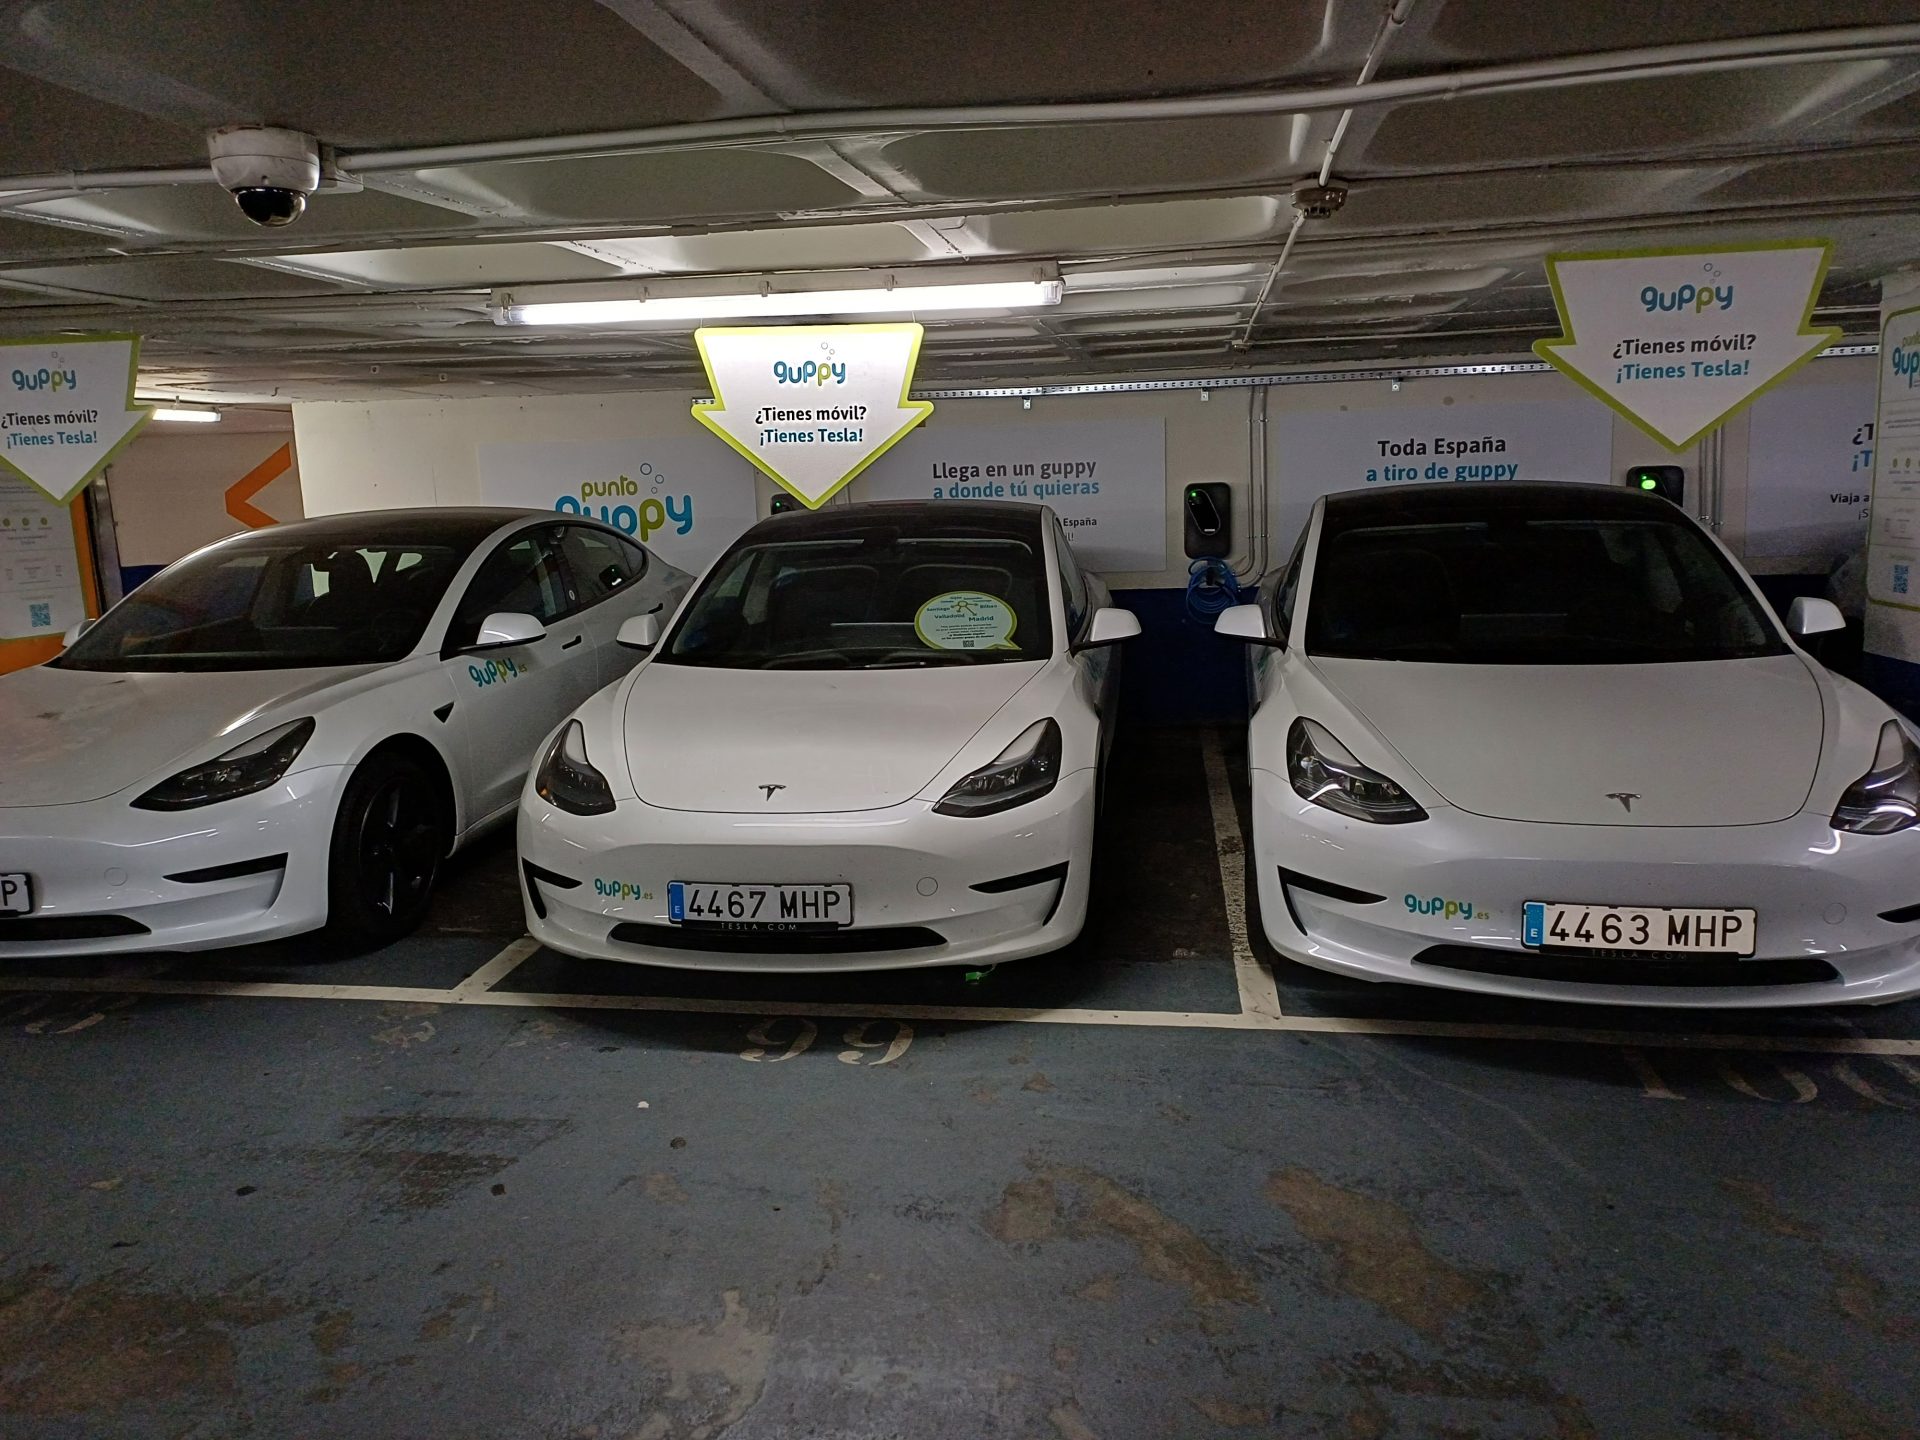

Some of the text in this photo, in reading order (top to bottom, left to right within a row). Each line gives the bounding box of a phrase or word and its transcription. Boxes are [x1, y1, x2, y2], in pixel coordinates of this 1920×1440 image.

[1640, 284, 1734, 313] guppy
[1612, 334, 1757, 359] ¿Tienes móvil?
[12, 368, 77, 392] guppy
[773, 360, 846, 386] guppy
[1616, 359, 1750, 384] ¡Tienes Tesla!
[1, 409, 98, 429] ¿Tienes móvil?
[755, 405, 867, 425] ¿Tienes móvil?
[7, 430, 97, 449] ¡Tienes Tesla!
[760, 428, 863, 446] ¡Tienes Tesla!
[1377, 436, 1506, 458] Toda España
[932, 461, 1097, 482] Llega en un guppy
[1366, 462, 1519, 482] a tiro de guppy
[581, 475, 638, 502] punto
[933, 480, 1100, 500] a donde tú quieras
[1830, 493, 1860, 506] Viaja
[1063, 516, 1097, 529] España
[674, 906, 680, 914] E
[688, 890, 841, 919] 4467 MHP
[1530, 929, 1538, 938] E
[1549, 910, 1743, 947] 4463 MHP
[739, 1016, 915, 1066] 99
